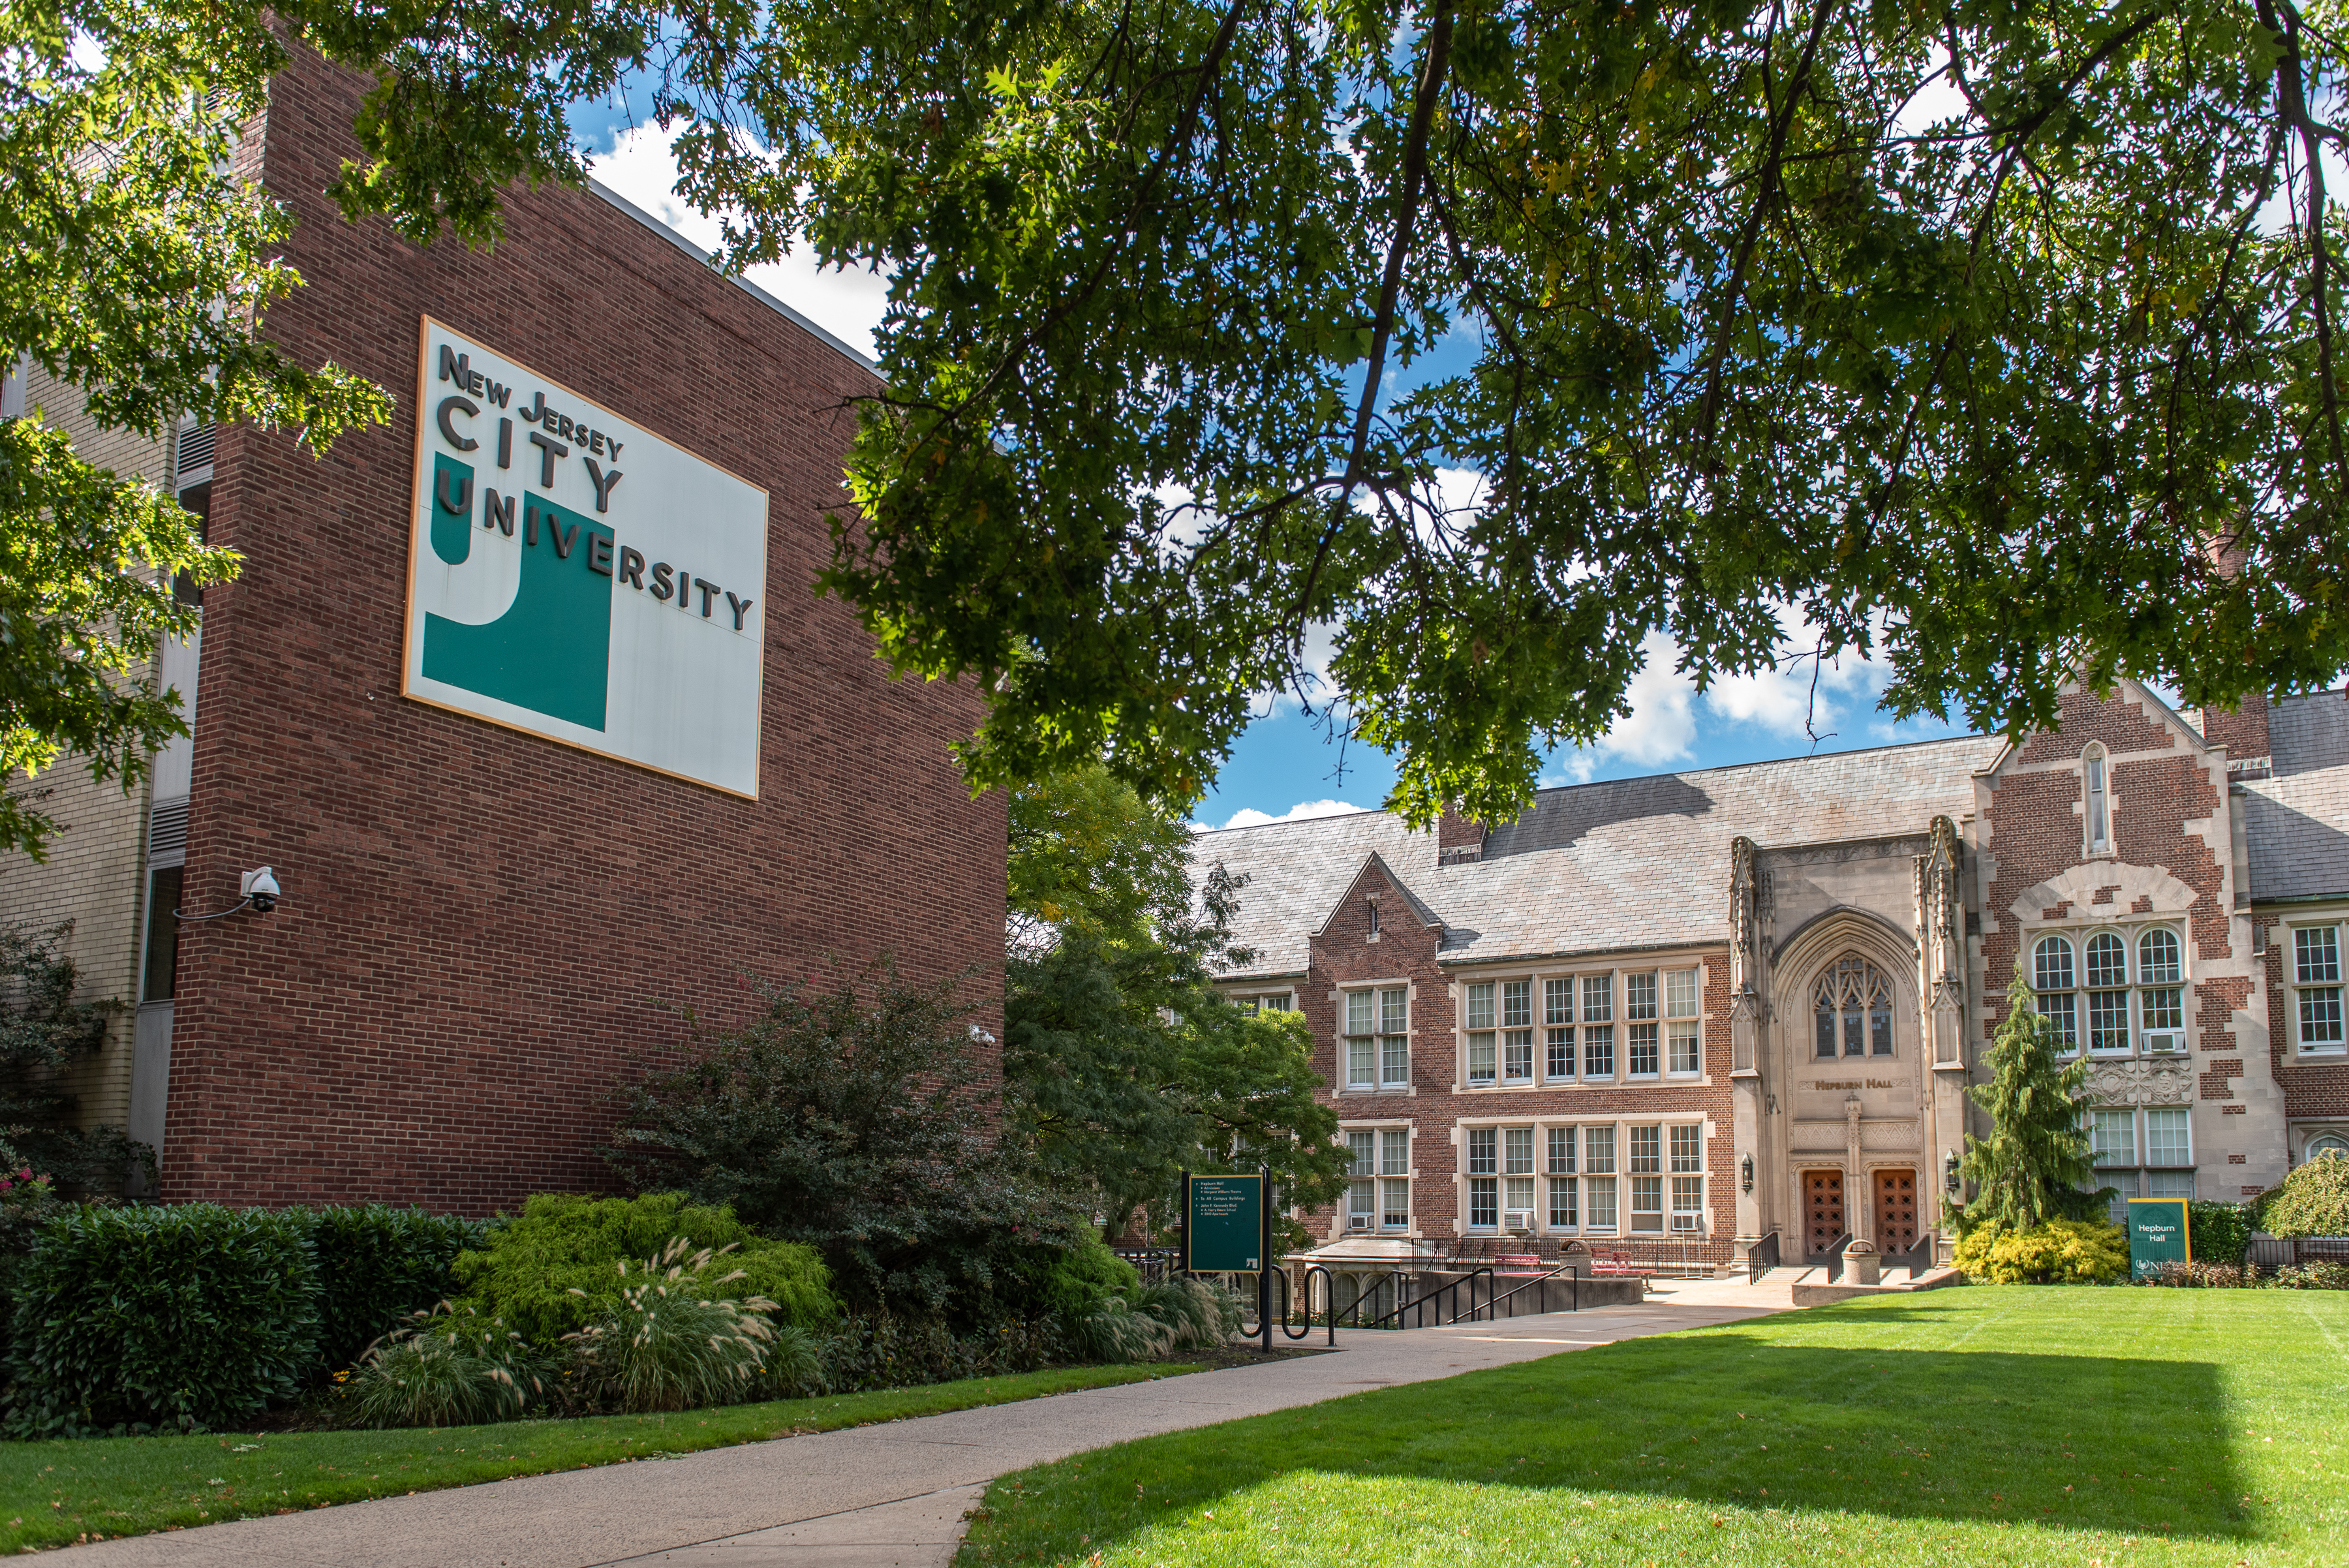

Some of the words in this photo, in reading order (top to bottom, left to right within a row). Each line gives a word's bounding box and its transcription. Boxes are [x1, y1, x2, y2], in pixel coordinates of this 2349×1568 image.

[437, 395, 624, 513] CITY
[439, 344, 512, 408] NEW
[519, 392, 624, 461] JERSEY
[438, 468, 754, 631] UNIVERSITY
[1815, 1080, 1862, 1090] HEPBURN
[1866, 1078, 1893, 1088] HALL
[2138, 1224, 2175, 1233] Hepburn
